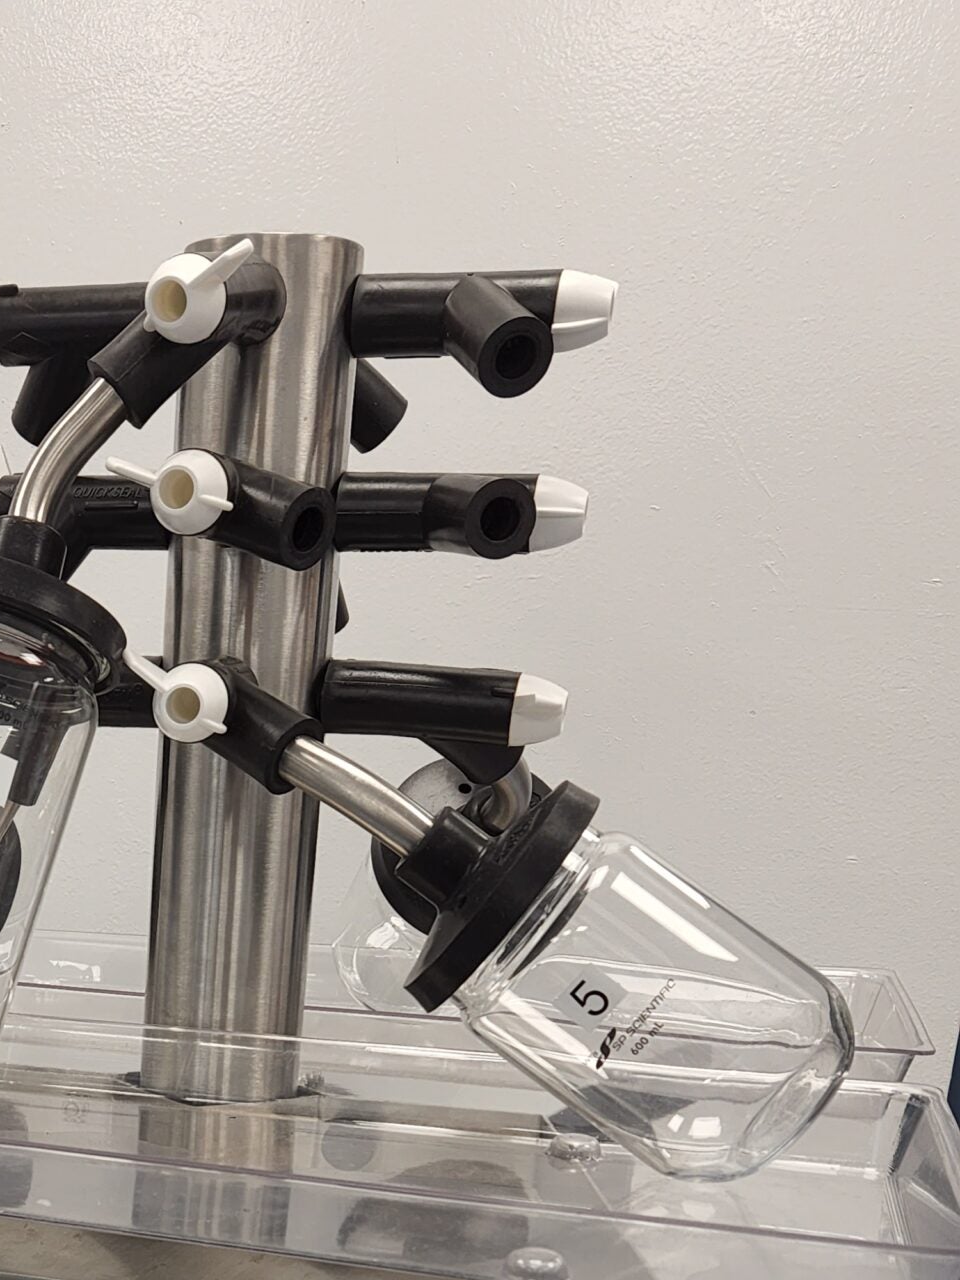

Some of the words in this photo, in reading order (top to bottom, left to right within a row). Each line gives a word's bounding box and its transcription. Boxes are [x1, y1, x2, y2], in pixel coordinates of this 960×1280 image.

[570, 980, 609, 1016] 5
[612, 1034, 627, 1052] SP
[626, 978, 676, 1037] SCIENTIFIC
[631, 1037, 649, 1055] 600
[649, 1022, 664, 1037] mL
